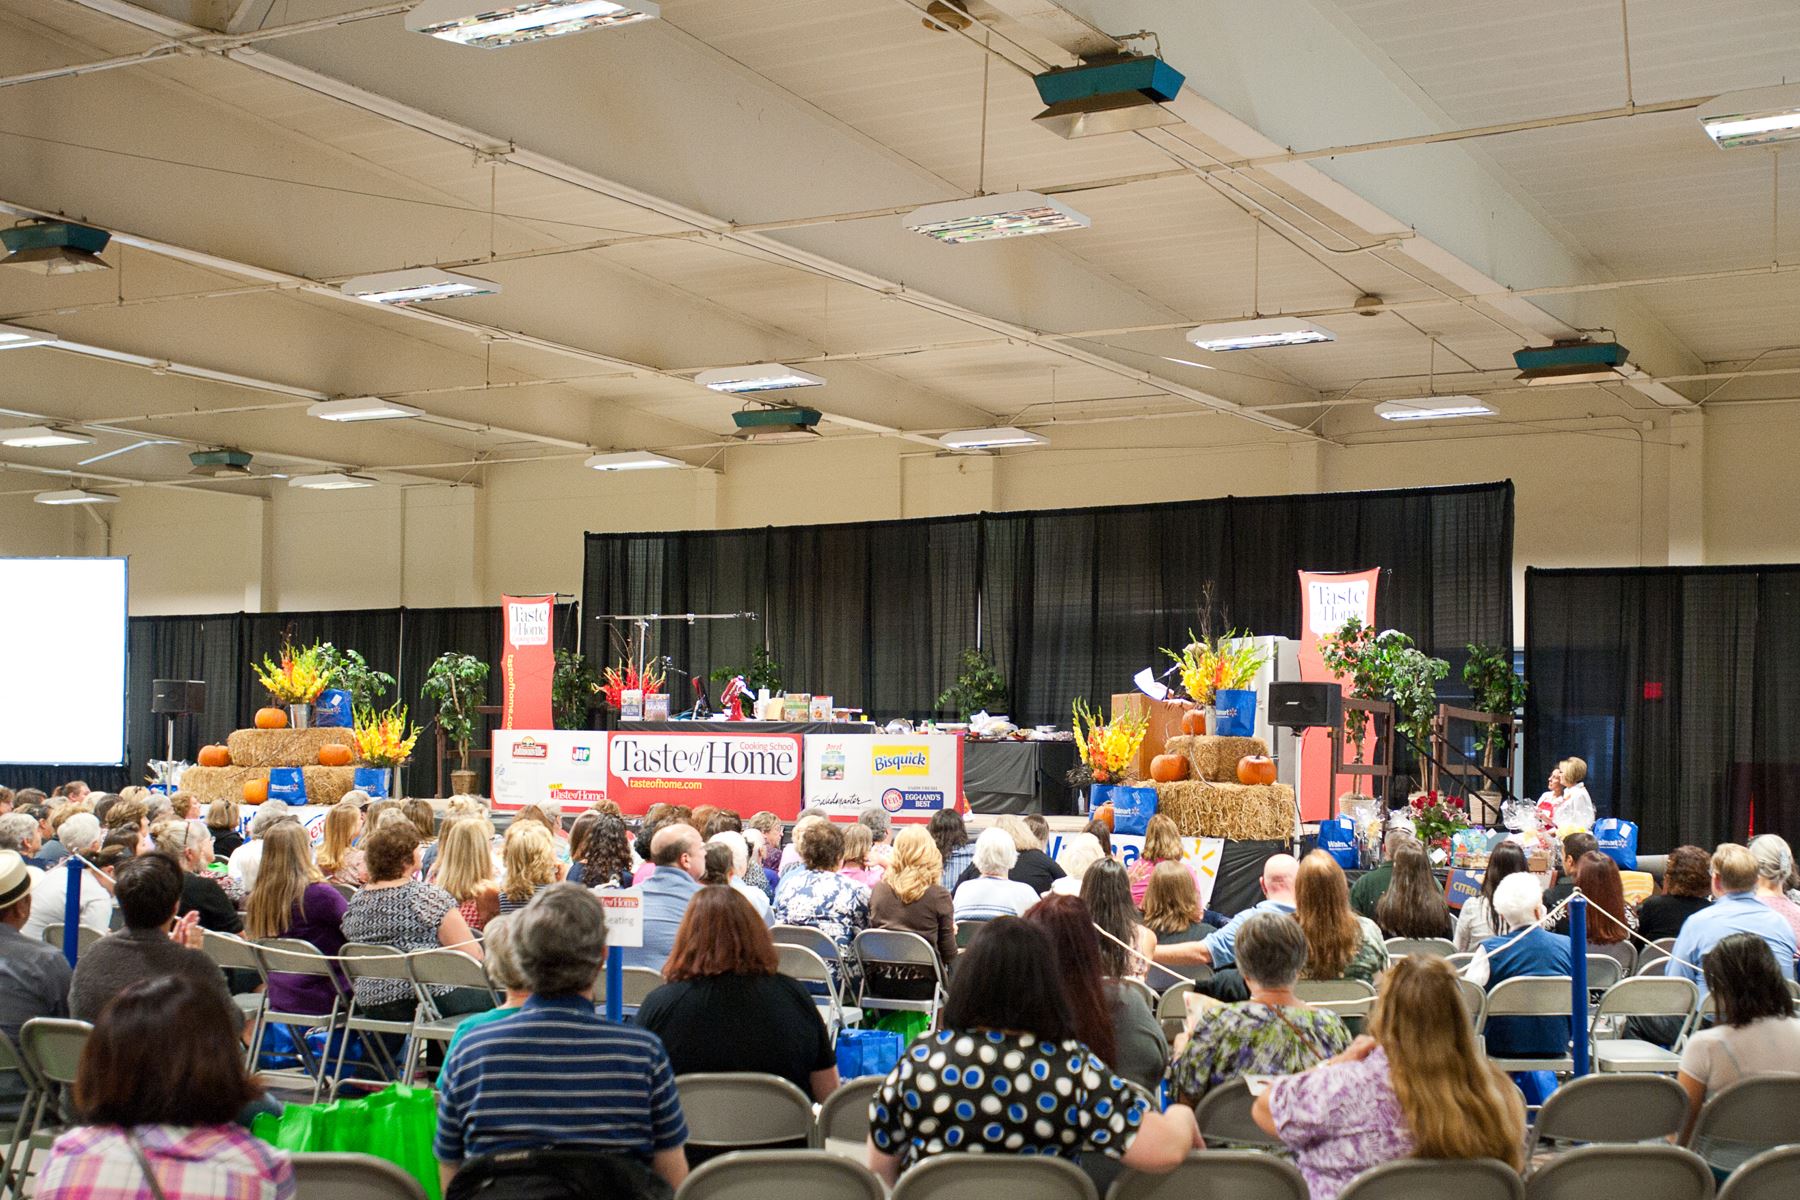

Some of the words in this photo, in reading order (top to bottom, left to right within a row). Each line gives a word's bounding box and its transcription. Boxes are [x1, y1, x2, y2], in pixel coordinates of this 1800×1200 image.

[511, 605, 547, 622] Taste
[740, 742, 768, 752] Cooking
[769, 742, 794, 751] School
[615, 740, 688, 773] Taste
[689, 744, 709, 771] of
[707, 742, 793, 776] Home
[875, 752, 926, 771] Bisquick
[630, 779, 702, 790] tasteofhome.com
[552, 789, 572, 800] Taste
[578, 790, 604, 801] Home
